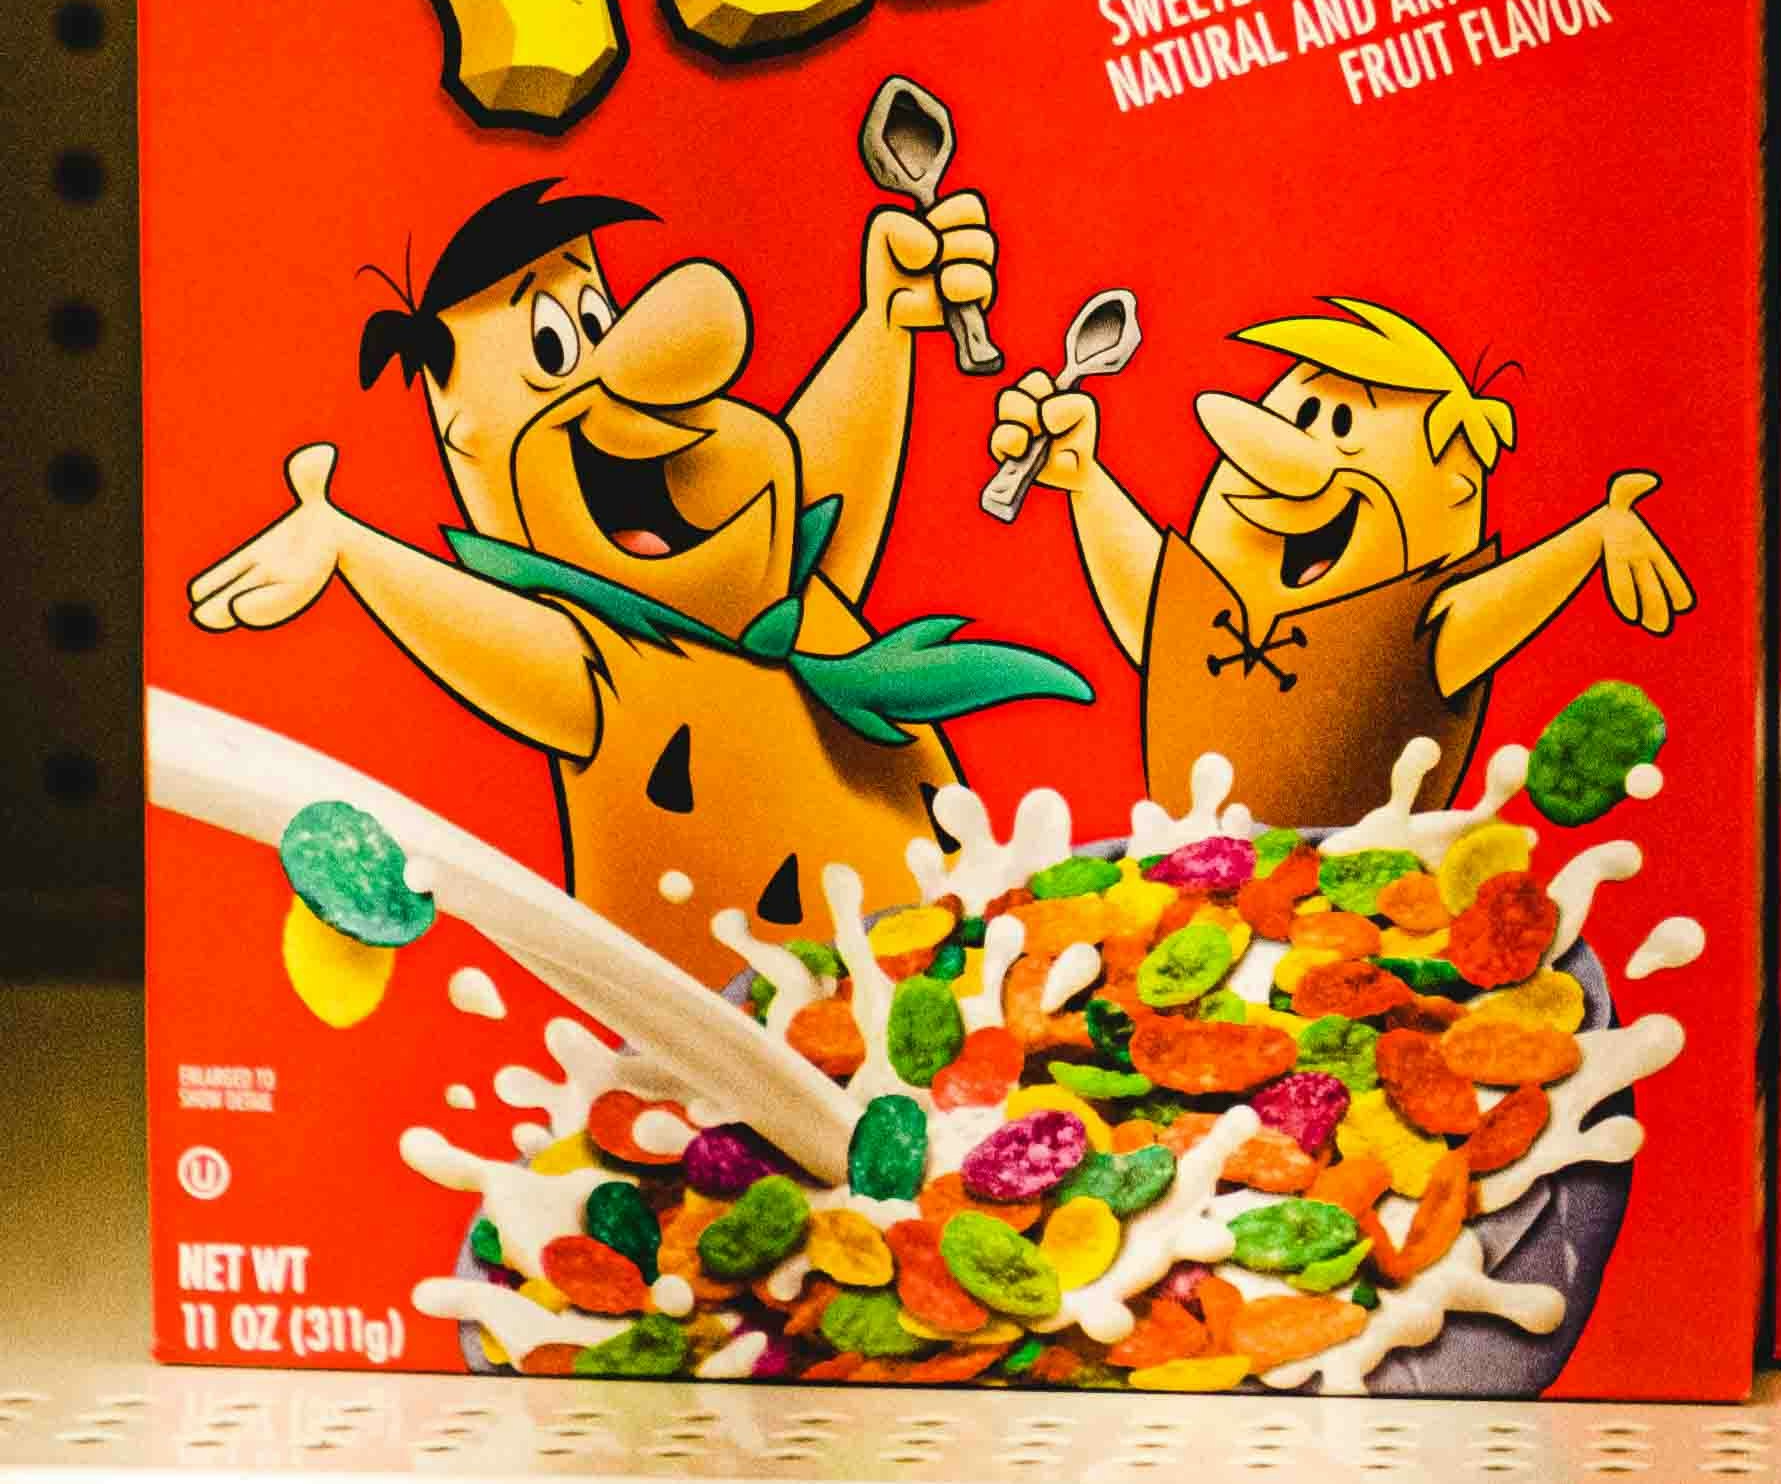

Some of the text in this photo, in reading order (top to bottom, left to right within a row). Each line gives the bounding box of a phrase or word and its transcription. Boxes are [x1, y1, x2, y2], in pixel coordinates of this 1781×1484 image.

[1105, 10, 1288, 113] NATURAL
[1339, 21, 1454, 105] FRUIT
[178, 1243, 309, 1294] NET WT
[181, 1303, 406, 1364] 11 OZ (311g)
